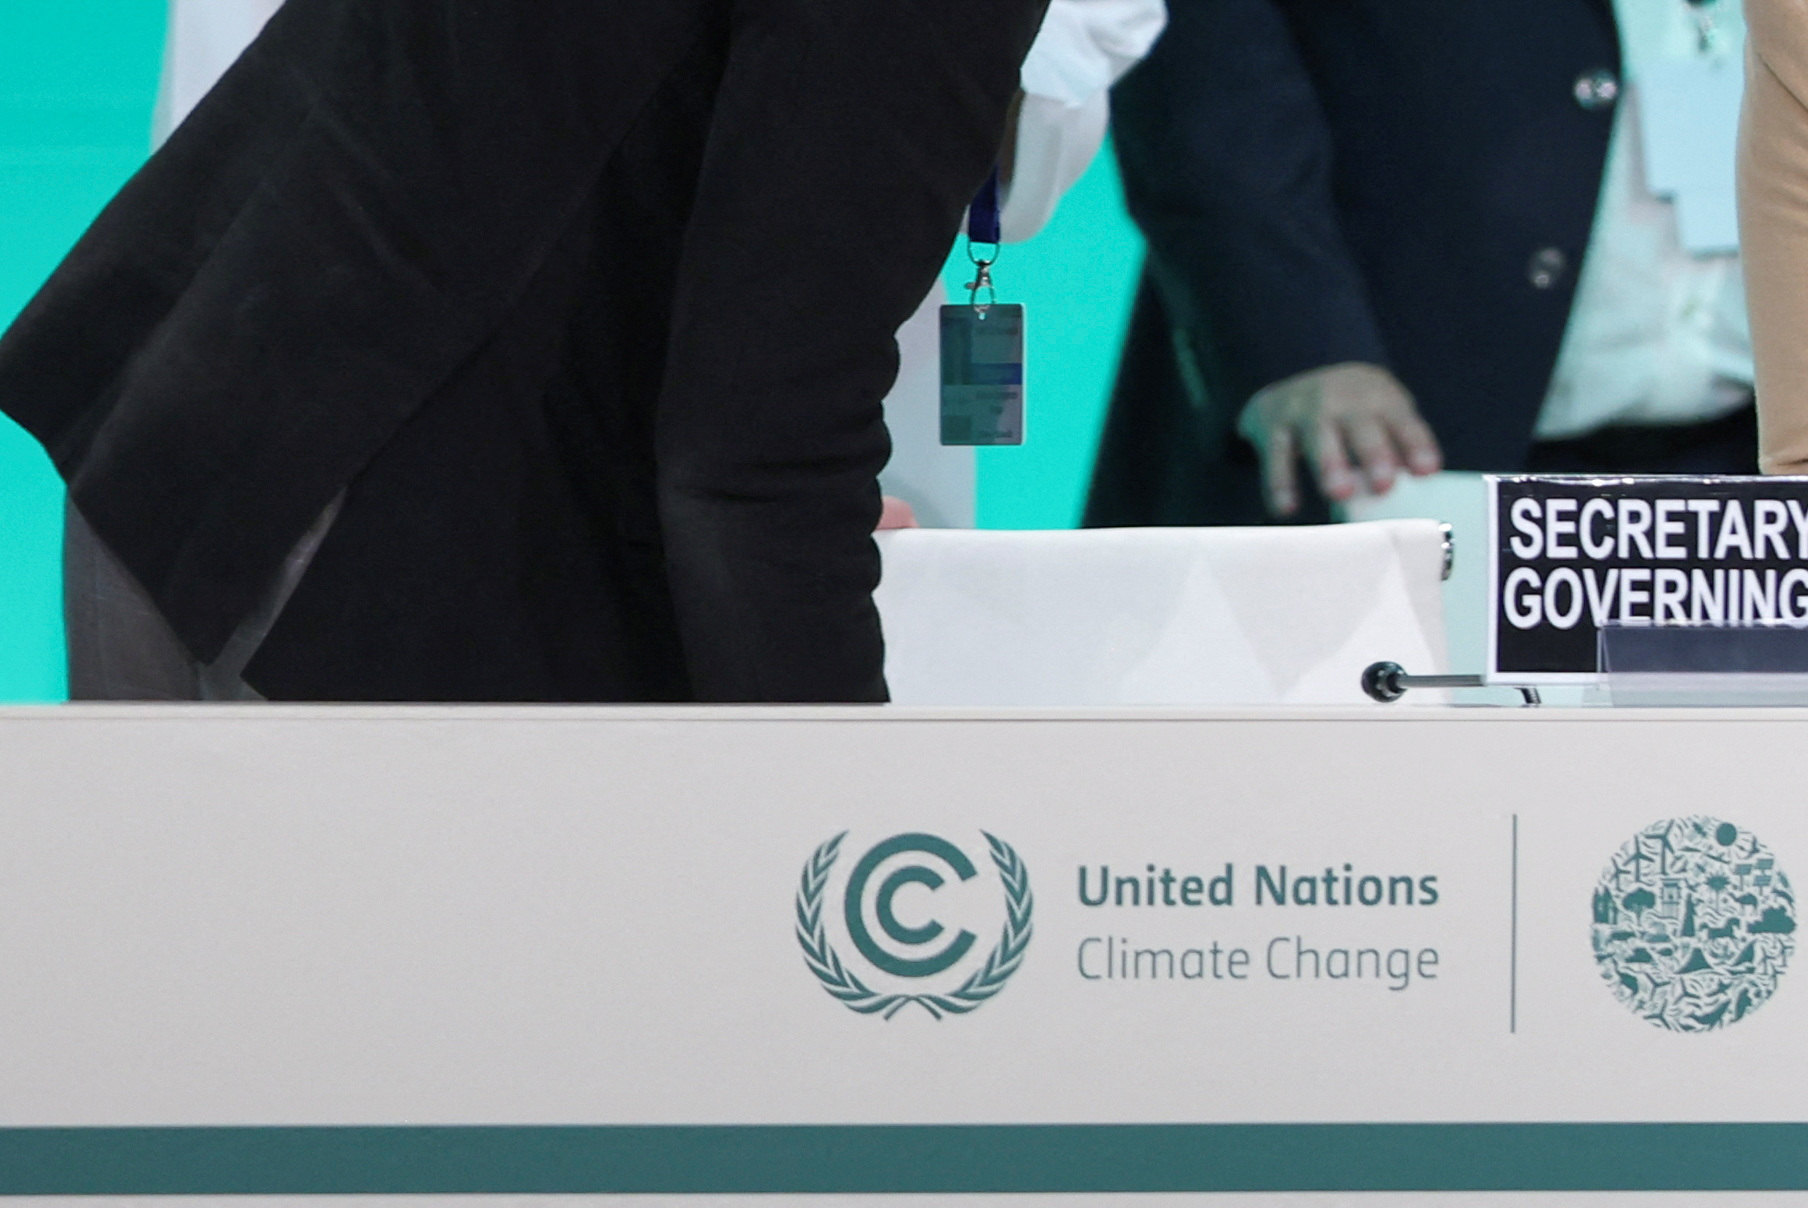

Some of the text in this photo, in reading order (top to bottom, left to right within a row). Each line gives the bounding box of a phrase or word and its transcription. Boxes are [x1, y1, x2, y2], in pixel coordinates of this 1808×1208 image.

[1078, 862, 1439, 908] United Nations
[1077, 935, 1440, 992] Climate Change
